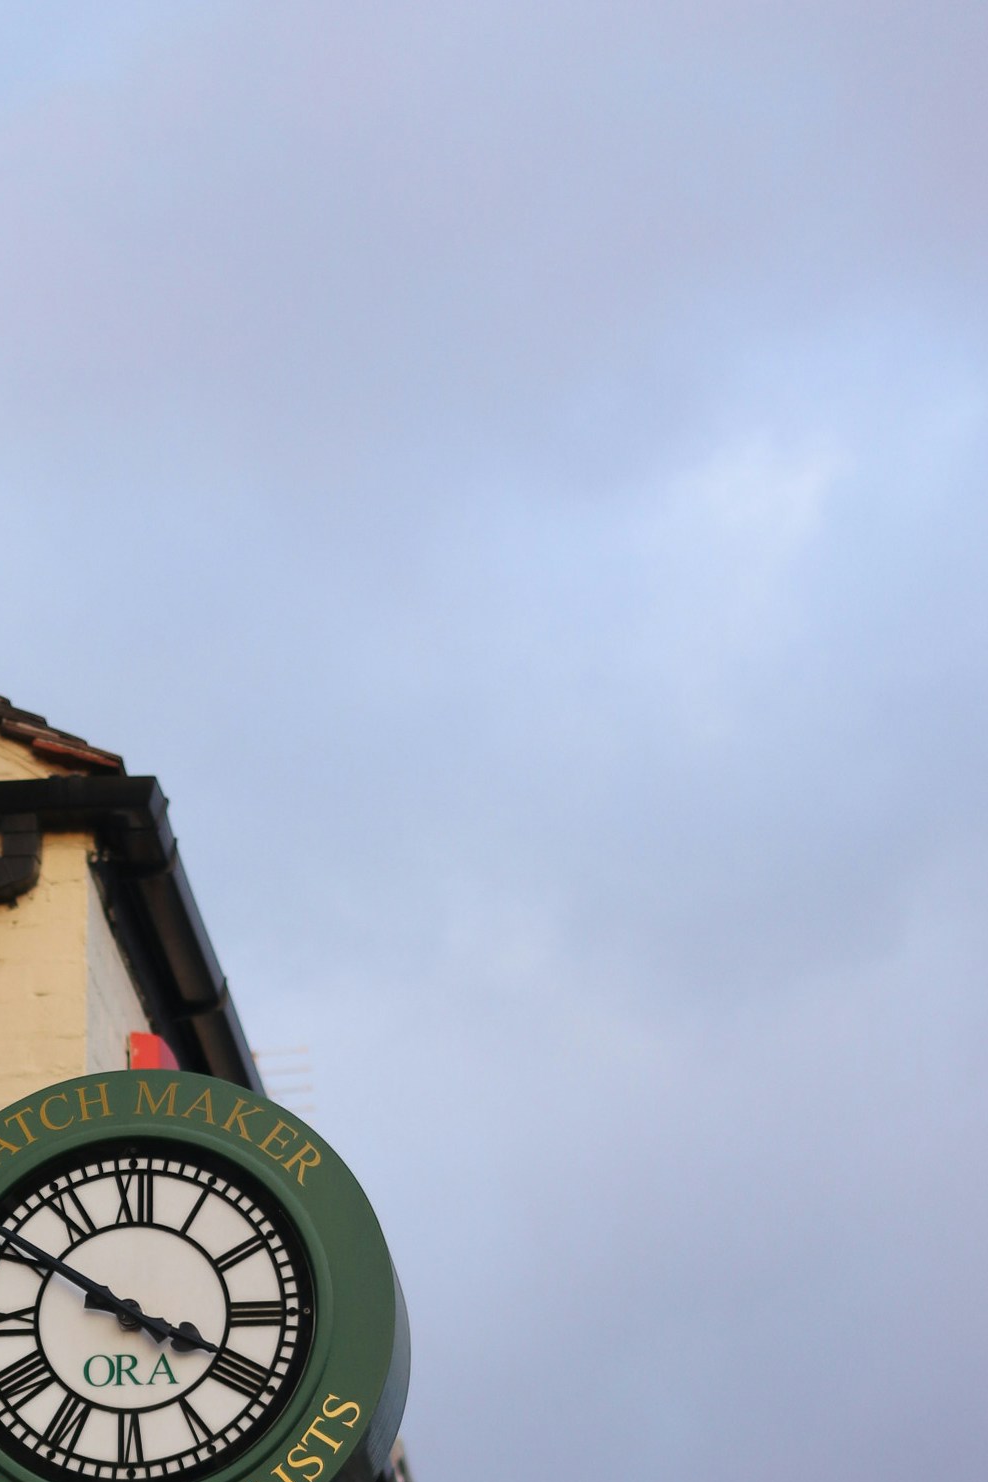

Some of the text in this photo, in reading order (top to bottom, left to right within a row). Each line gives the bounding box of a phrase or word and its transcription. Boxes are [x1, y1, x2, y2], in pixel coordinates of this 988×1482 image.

[133, 1081, 322, 1187] MAKER
[48, 1188, 97, 1244] XI
[112, 1168, 153, 1224] XII
[212, 1233, 264, 1274] II
[229, 1301, 283, 1326] III
[83, 1353, 179, 1387] ORA
[209, 1350, 272, 1398] IIII
[45, 1392, 91, 1449] VII
[117, 1411, 142, 1463] VI
[179, 1397, 215, 1447] V
